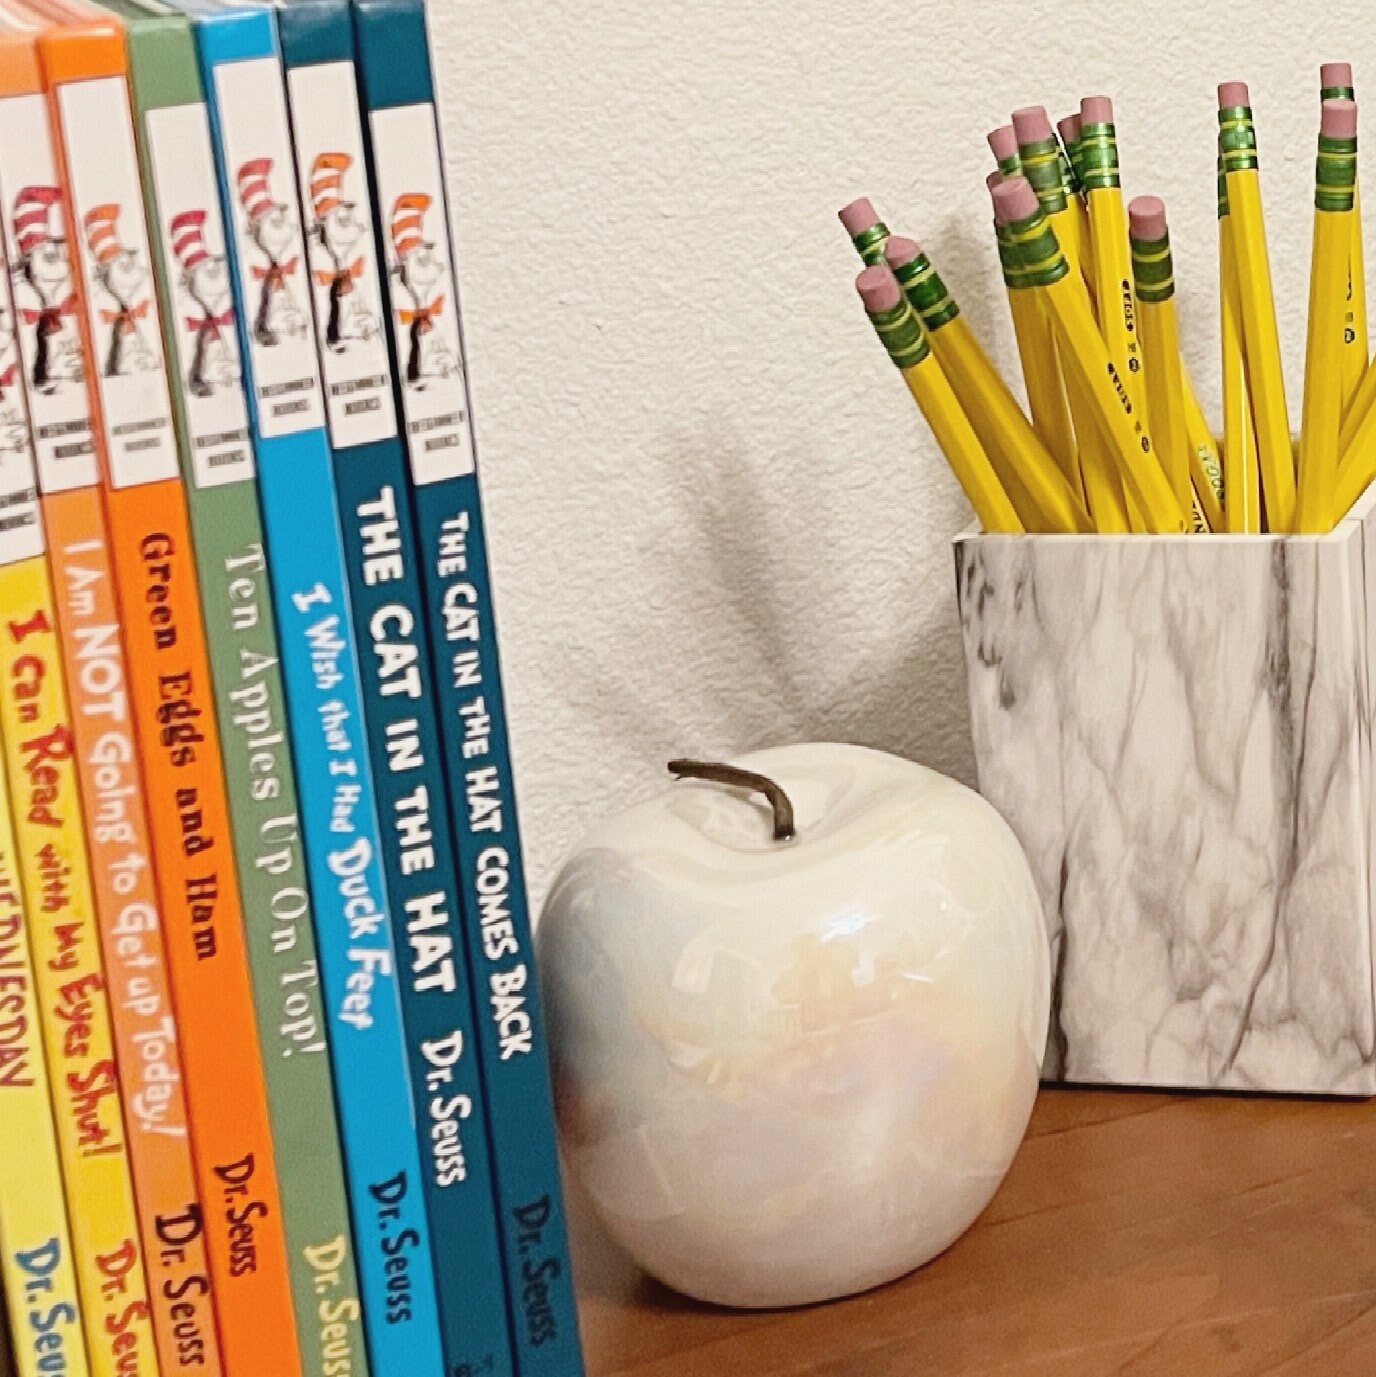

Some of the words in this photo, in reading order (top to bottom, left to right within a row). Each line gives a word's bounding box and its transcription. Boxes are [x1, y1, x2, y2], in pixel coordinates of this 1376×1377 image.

[63, 539, 104, 555] I
[356, 485, 405, 587] THE
[436, 510, 470, 579] THE
[64, 565, 106, 617] Am
[140, 532, 177, 651] Green
[225, 542, 267, 631] Ten
[291, 581, 333, 614] I
[441, 581, 480, 642] CAT
[8, 608, 54, 644] I
[304, 613, 347, 690] Wish
[369, 603, 423, 700] CAT
[12, 653, 47, 724] Can
[72, 623, 126, 721] NOT
[452, 649, 484, 689] IN
[156, 669, 205, 767] Eggs
[228, 645, 284, 801] Apples
[384, 717, 425, 772] IN
[457, 695, 492, 760] THE
[19, 723, 75, 828] Read
[88, 732, 138, 844] Going
[328, 758, 358, 777] I
[464, 764, 504, 833] HAT
[175, 787, 215, 858] and
[255, 812, 299, 876] Up
[329, 783, 363, 834] Had
[394, 784, 435, 876] THE
[35, 842, 72, 914] with
[107, 853, 148, 896] to
[326, 835, 386, 940] Duck
[475, 845, 520, 962] COMES
[48, 921, 86, 973] My
[110, 901, 160, 969] Get
[185, 871, 219, 962] Ham
[270, 886, 309, 954] On
[403, 890, 457, 993] HAT
[54, 972, 106, 1059] Eyes
[121, 976, 162, 1017] up
[279, 957, 327, 1059] Top!
[337, 949, 393, 1031] Feet
[489, 963, 534, 1061] BACK
[131, 1015, 188, 1137] Today!
[420, 1029, 464, 1092] Dr.
[430, 1093, 473, 1188] Seuss
[213, 1151, 255, 1204] Dr.
[368, 1168, 408, 1231] Dr.
[154, 1202, 204, 1268] Dr.
[225, 1200, 269, 1278] Seuss
[512, 1192, 551, 1256] Dr.
[14, 1237, 61, 1304] Dr.
[95, 1238, 138, 1302] Dr.
[302, 1234, 347, 1295] Dr.
[380, 1226, 421, 1325] Seuss
[29, 1300, 78, 1377] Seu
[104, 1300, 151, 1377] Seu
[163, 1275, 210, 1368] Seuss
[318, 1296, 362, 1377] Seus
[521, 1255, 562, 1350] Seuss
